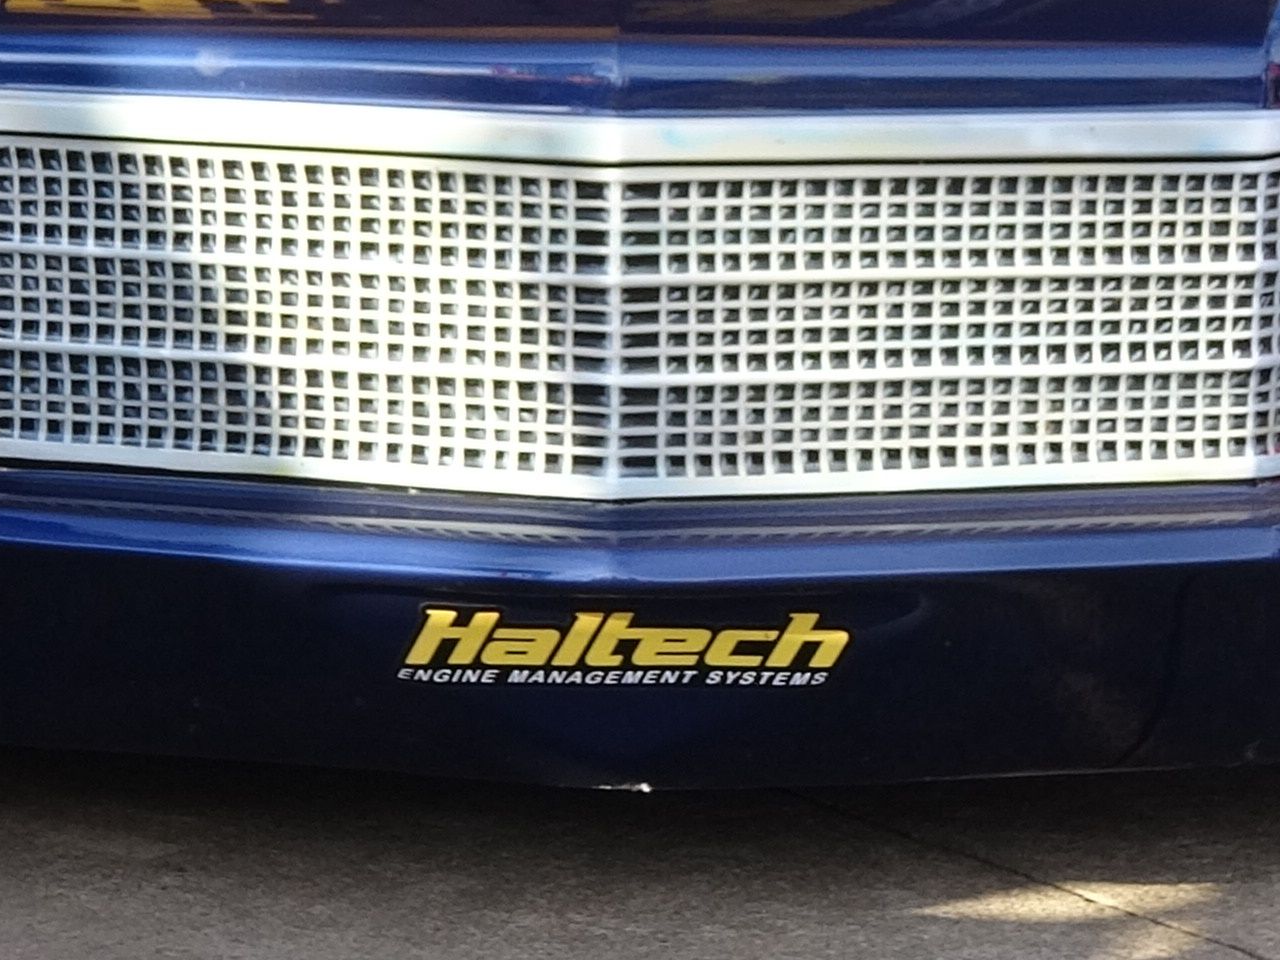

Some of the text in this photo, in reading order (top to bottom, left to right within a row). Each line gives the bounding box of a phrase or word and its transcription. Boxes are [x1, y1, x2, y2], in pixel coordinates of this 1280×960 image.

[403, 608, 850, 668] Haltech
[397, 668, 829, 687] ENGINE MANAGEMENT SYSTEMS
